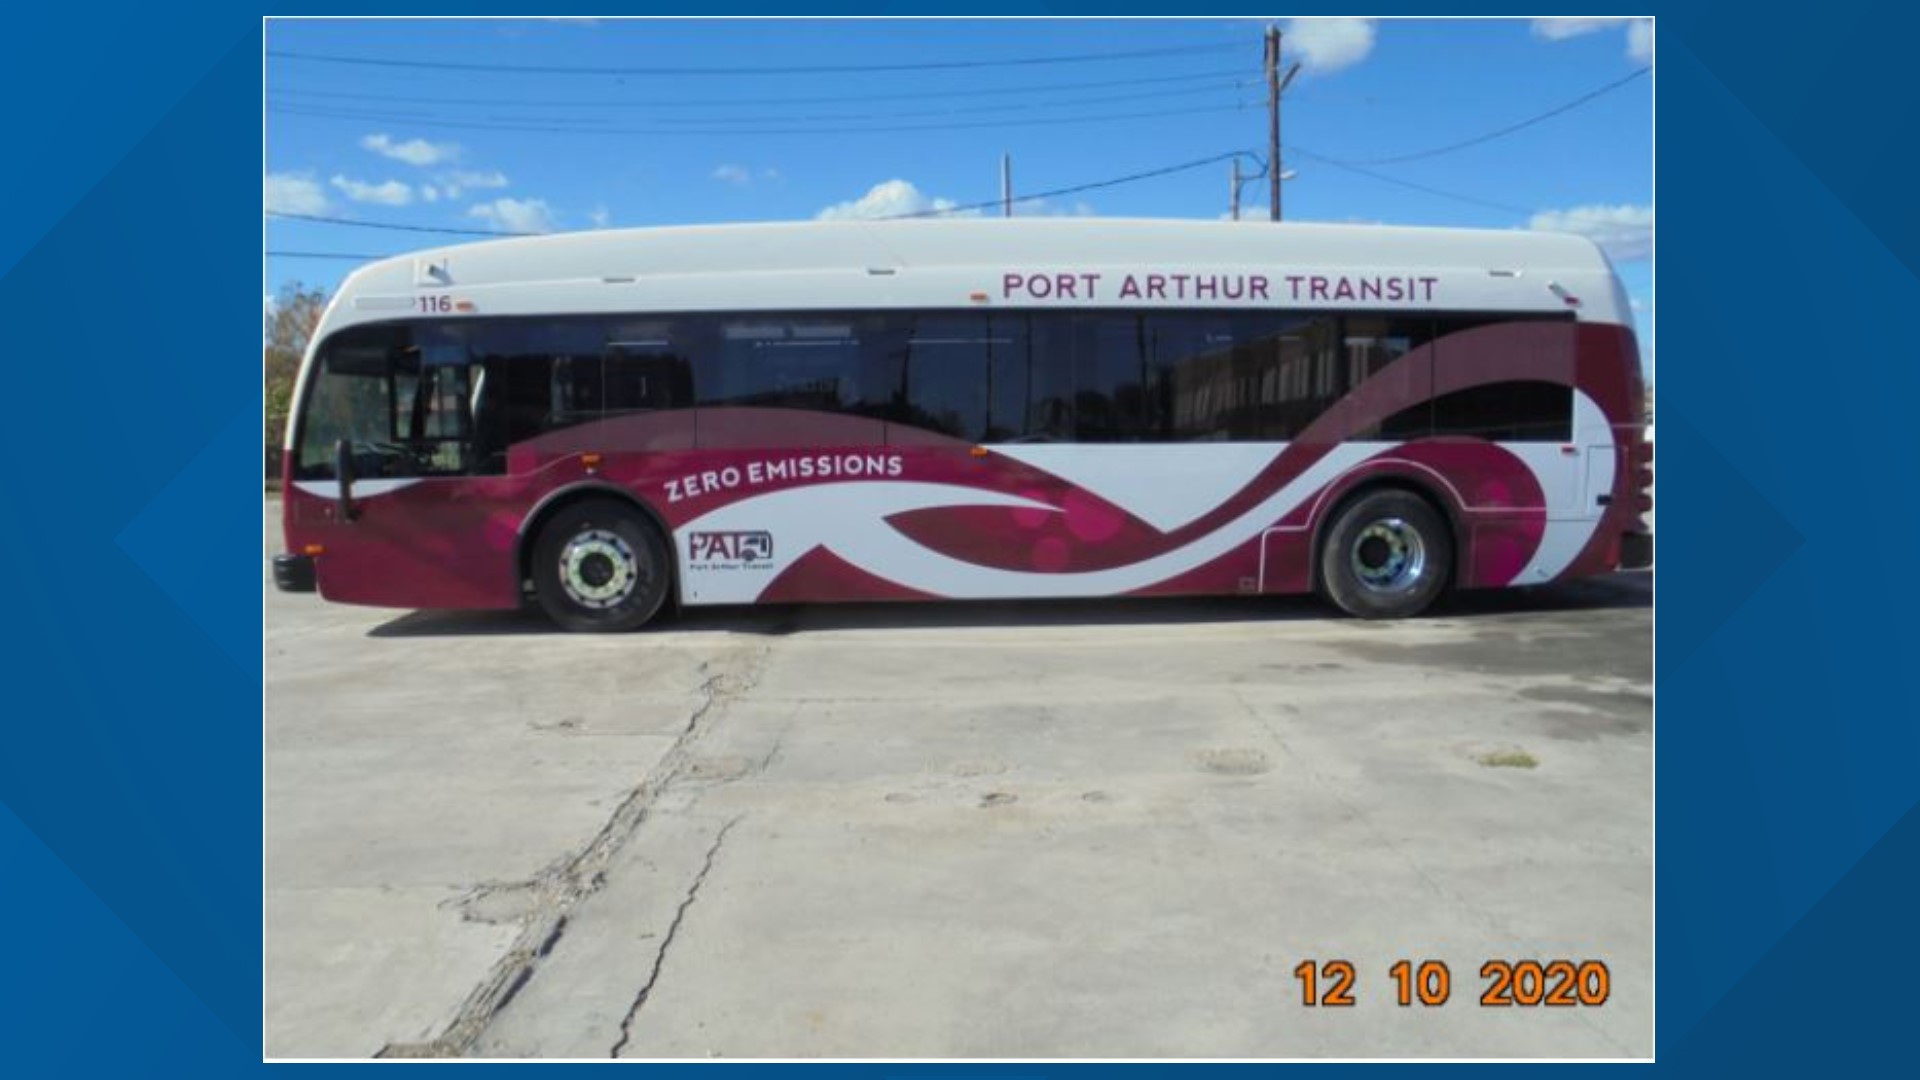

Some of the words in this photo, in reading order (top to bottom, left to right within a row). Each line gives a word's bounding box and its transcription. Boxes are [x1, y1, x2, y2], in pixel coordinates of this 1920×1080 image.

[1002, 273, 1101, 300] PORT
[1118, 274, 1270, 301] ARTHUR
[1285, 275, 1439, 302] TRANSIT
[418, 294, 453, 313] 116
[663, 466, 741, 503] ZERO
[747, 454, 904, 484] EMISSIONS
